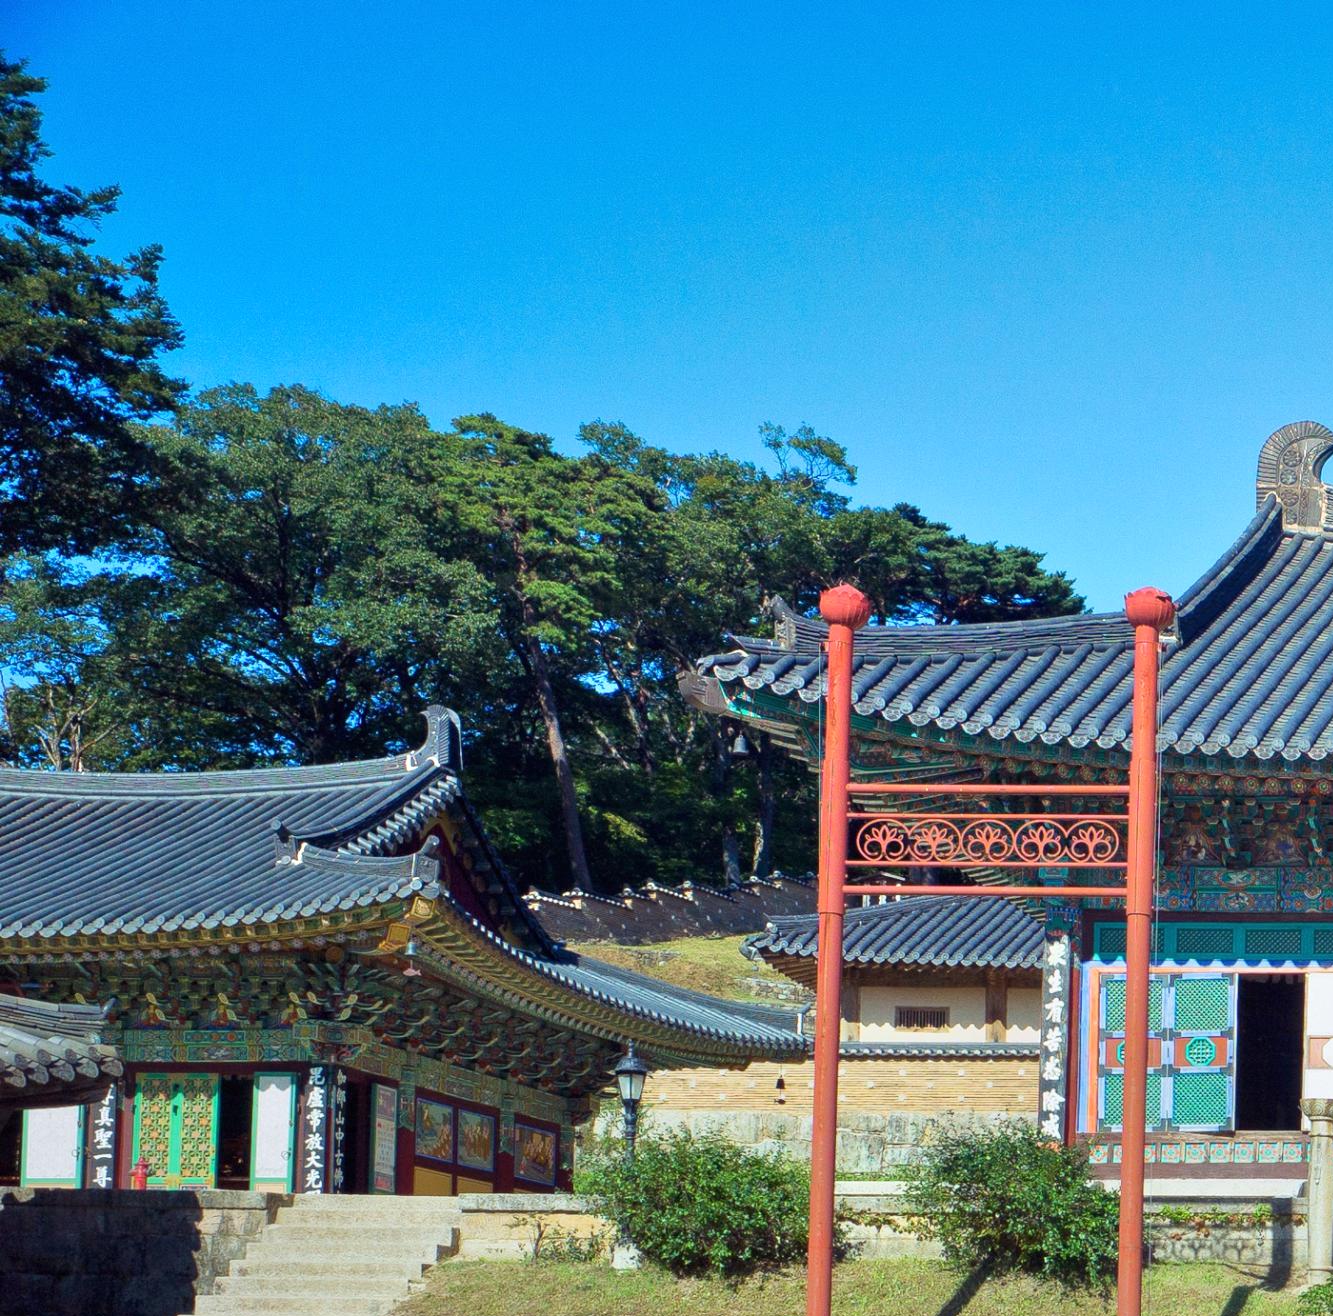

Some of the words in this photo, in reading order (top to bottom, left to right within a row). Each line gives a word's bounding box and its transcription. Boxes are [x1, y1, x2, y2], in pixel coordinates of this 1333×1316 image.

[304, 1066, 325, 1194] 毘盧常放大光
